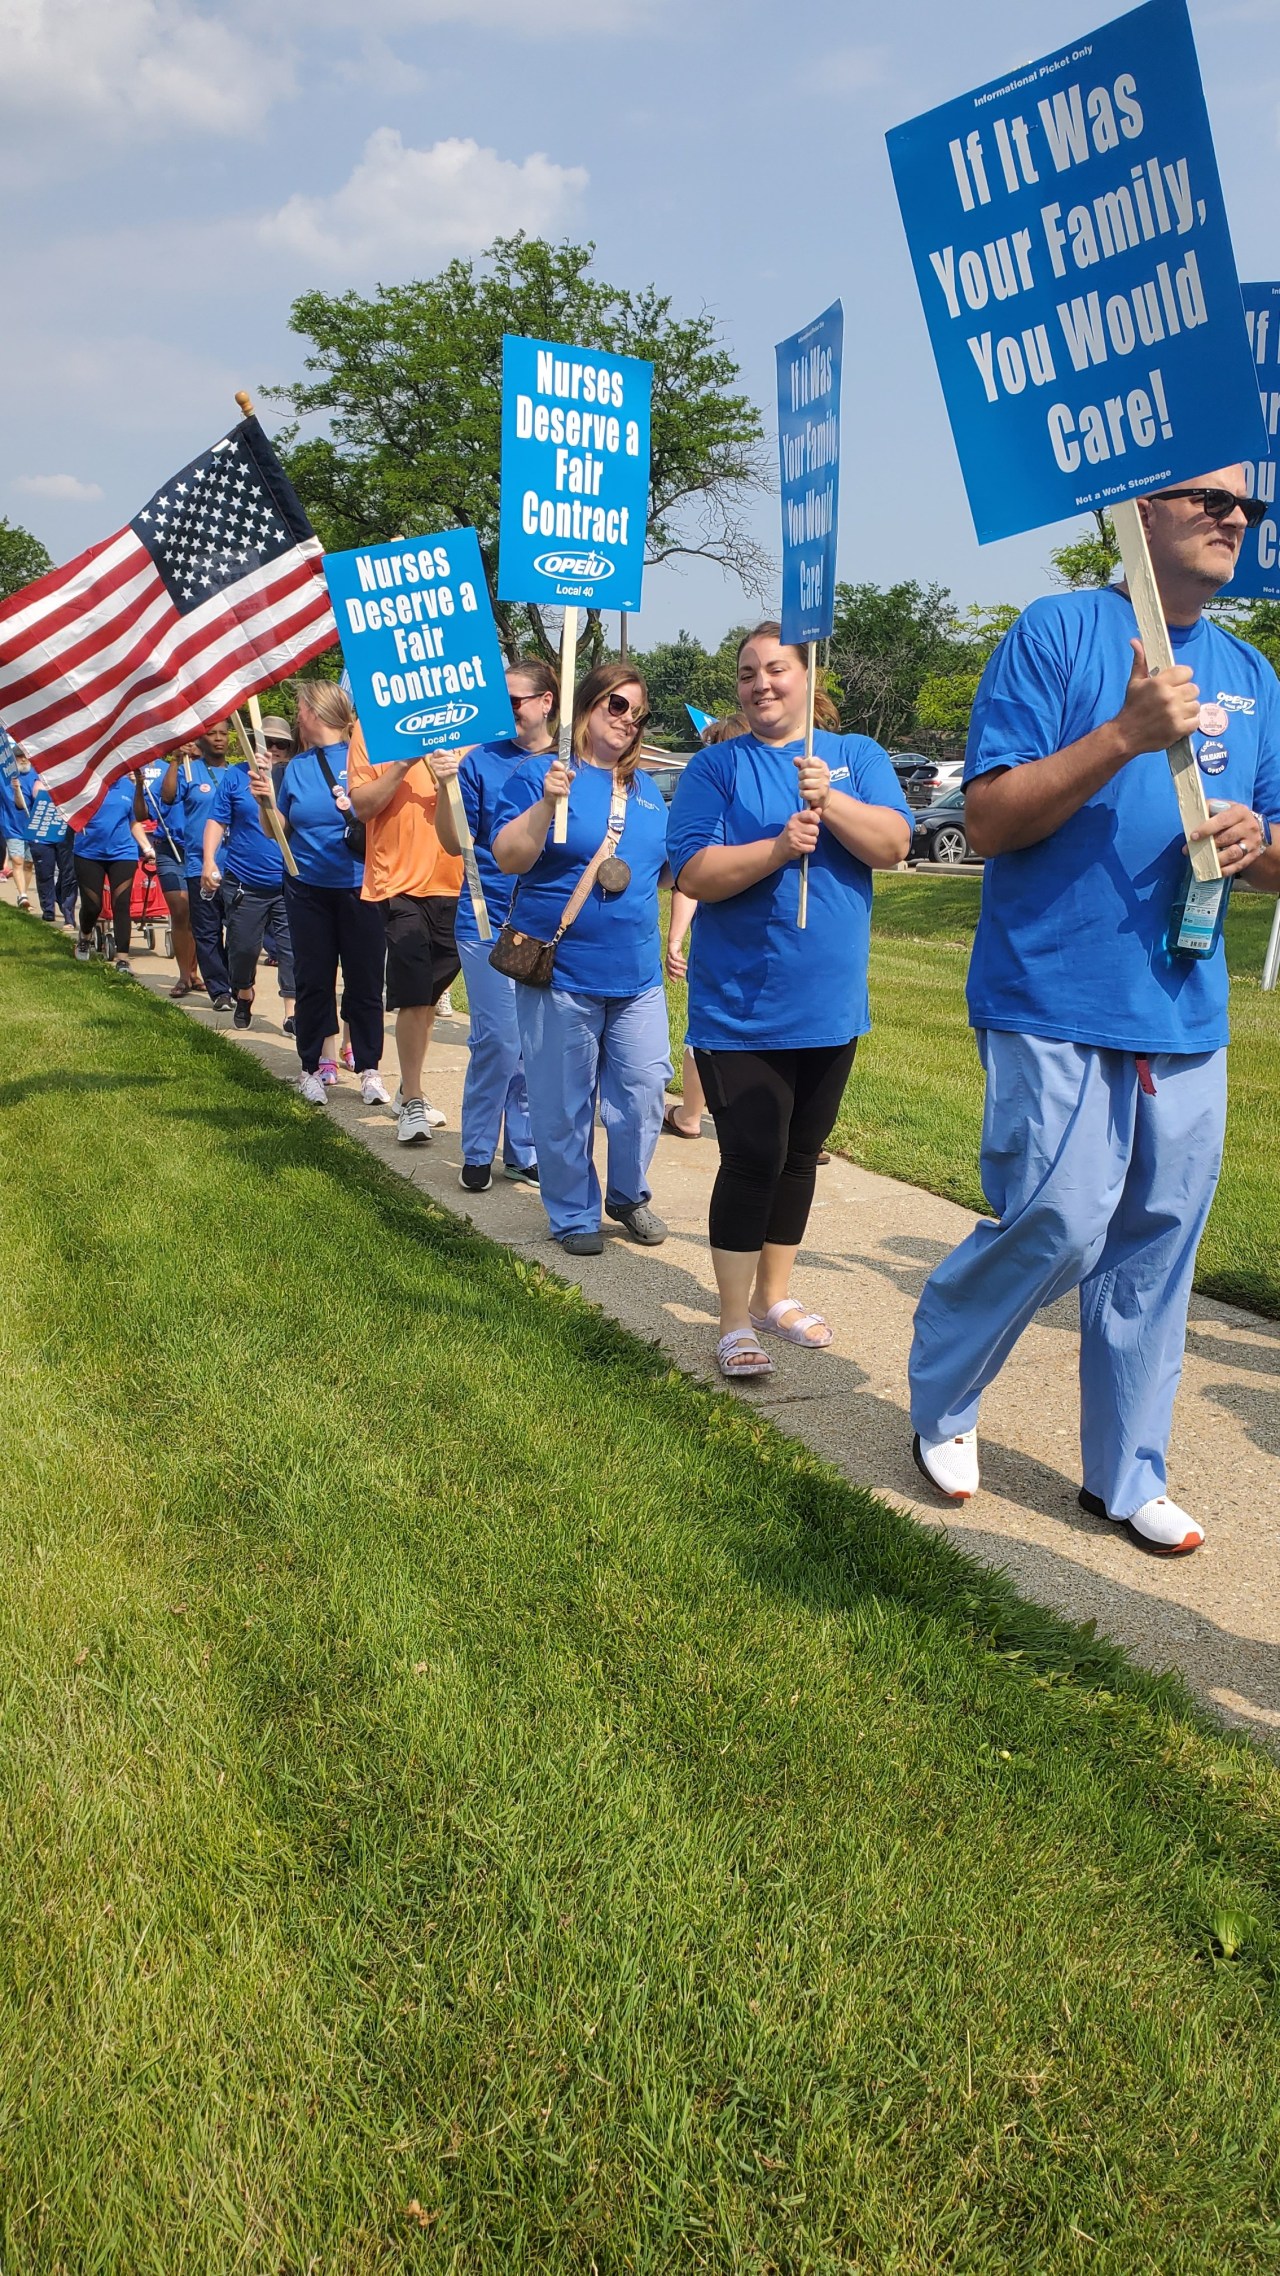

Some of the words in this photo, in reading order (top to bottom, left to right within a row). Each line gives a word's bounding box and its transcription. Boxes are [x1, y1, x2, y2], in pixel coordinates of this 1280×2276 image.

[974, 71, 1037, 107] Informational
[1039, 56, 1070, 77] Picket
[1072, 45, 1092, 61] Only
[949, 129, 991, 212] If
[993, 116, 1039, 193] It
[1037, 73, 1144, 173] Was
[929, 226, 1035, 319] Your
[1040, 157, 1207, 278] Family,
[967, 324, 1056, 403] You
[1056, 250, 1208, 374] Would
[537, 350, 623, 408] Nurses
[791, 360, 799, 413] If
[801, 356, 808, 407] It
[810, 344, 832, 401] Was
[516, 394, 620, 452] Deserve
[626, 420, 639, 456] a
[783, 433, 805, 483] Your
[807, 409, 837, 474] Family,
[1046, 369, 1173, 474] Care!
[555, 448, 604, 496] Fair
[1075, 495, 1093, 506] Not
[1102, 484, 1127, 497] Work
[1128, 469, 1172, 489] Stoppage
[1241, 461, 1276, 502] ou
[522, 490, 629, 546] Contract
[787, 498, 804, 548] You
[806, 479, 834, 542] Would
[355, 547, 450, 592] Nurses
[556, 584, 582, 596] Local
[582, 587, 594, 597] 40
[800, 555, 824, 611] Care!
[345, 585, 454, 634] Deserve
[459, 582, 478, 612] a
[393, 624, 444, 664] Fair
[371, 655, 487, 708] Contract
[422, 734, 446, 746] Local
[448, 731, 460, 741] 40
[1200, 751, 1227, 762] SOLIDARITY
[1201, 740, 1216, 752] LOCAL
[1207, 765, 1225, 774] OPEIU
[28, 800, 47, 830] Nurses
